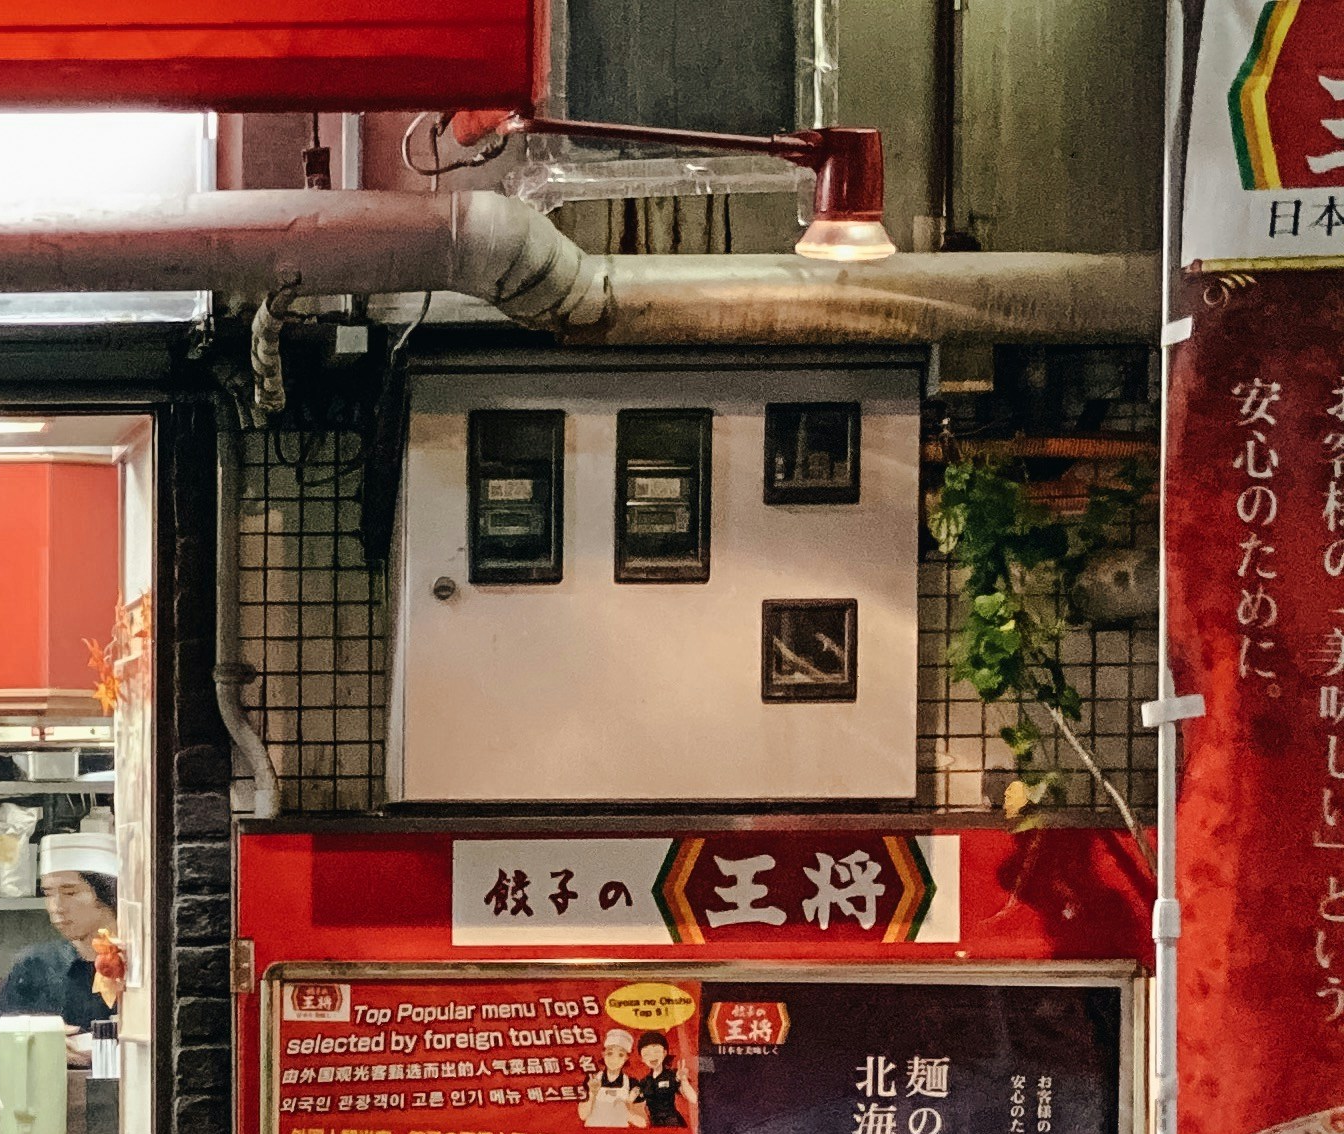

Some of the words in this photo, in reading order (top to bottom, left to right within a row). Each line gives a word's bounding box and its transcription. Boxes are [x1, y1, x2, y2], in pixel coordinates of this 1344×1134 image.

[1232, 377, 1282, 699] 安心のために。
[483, 849, 886, 930] 餃子の王将
[354, 1005, 390, 1026] Top
[397, 1001, 476, 1025] Popular
[482, 1001, 536, 1019] menu
[540, 998, 580, 1020] Top
[583, 996, 599, 1015] 5
[287, 1034, 386, 1056] selected
[390, 1032, 416, 1054] by
[423, 1029, 504, 1051] foreign
[508, 1026, 598, 1047] tourists
[724, 1020, 773, 1043] 王将
[718, 1046, 779, 1056] 日本を美味しく
[280, 1096, 331, 1112] 외국인
[338, 1092, 405, 1111] 관광객이
[451, 1089, 484, 1106] 인기
[489, 1088, 521, 1104] 메뉴
